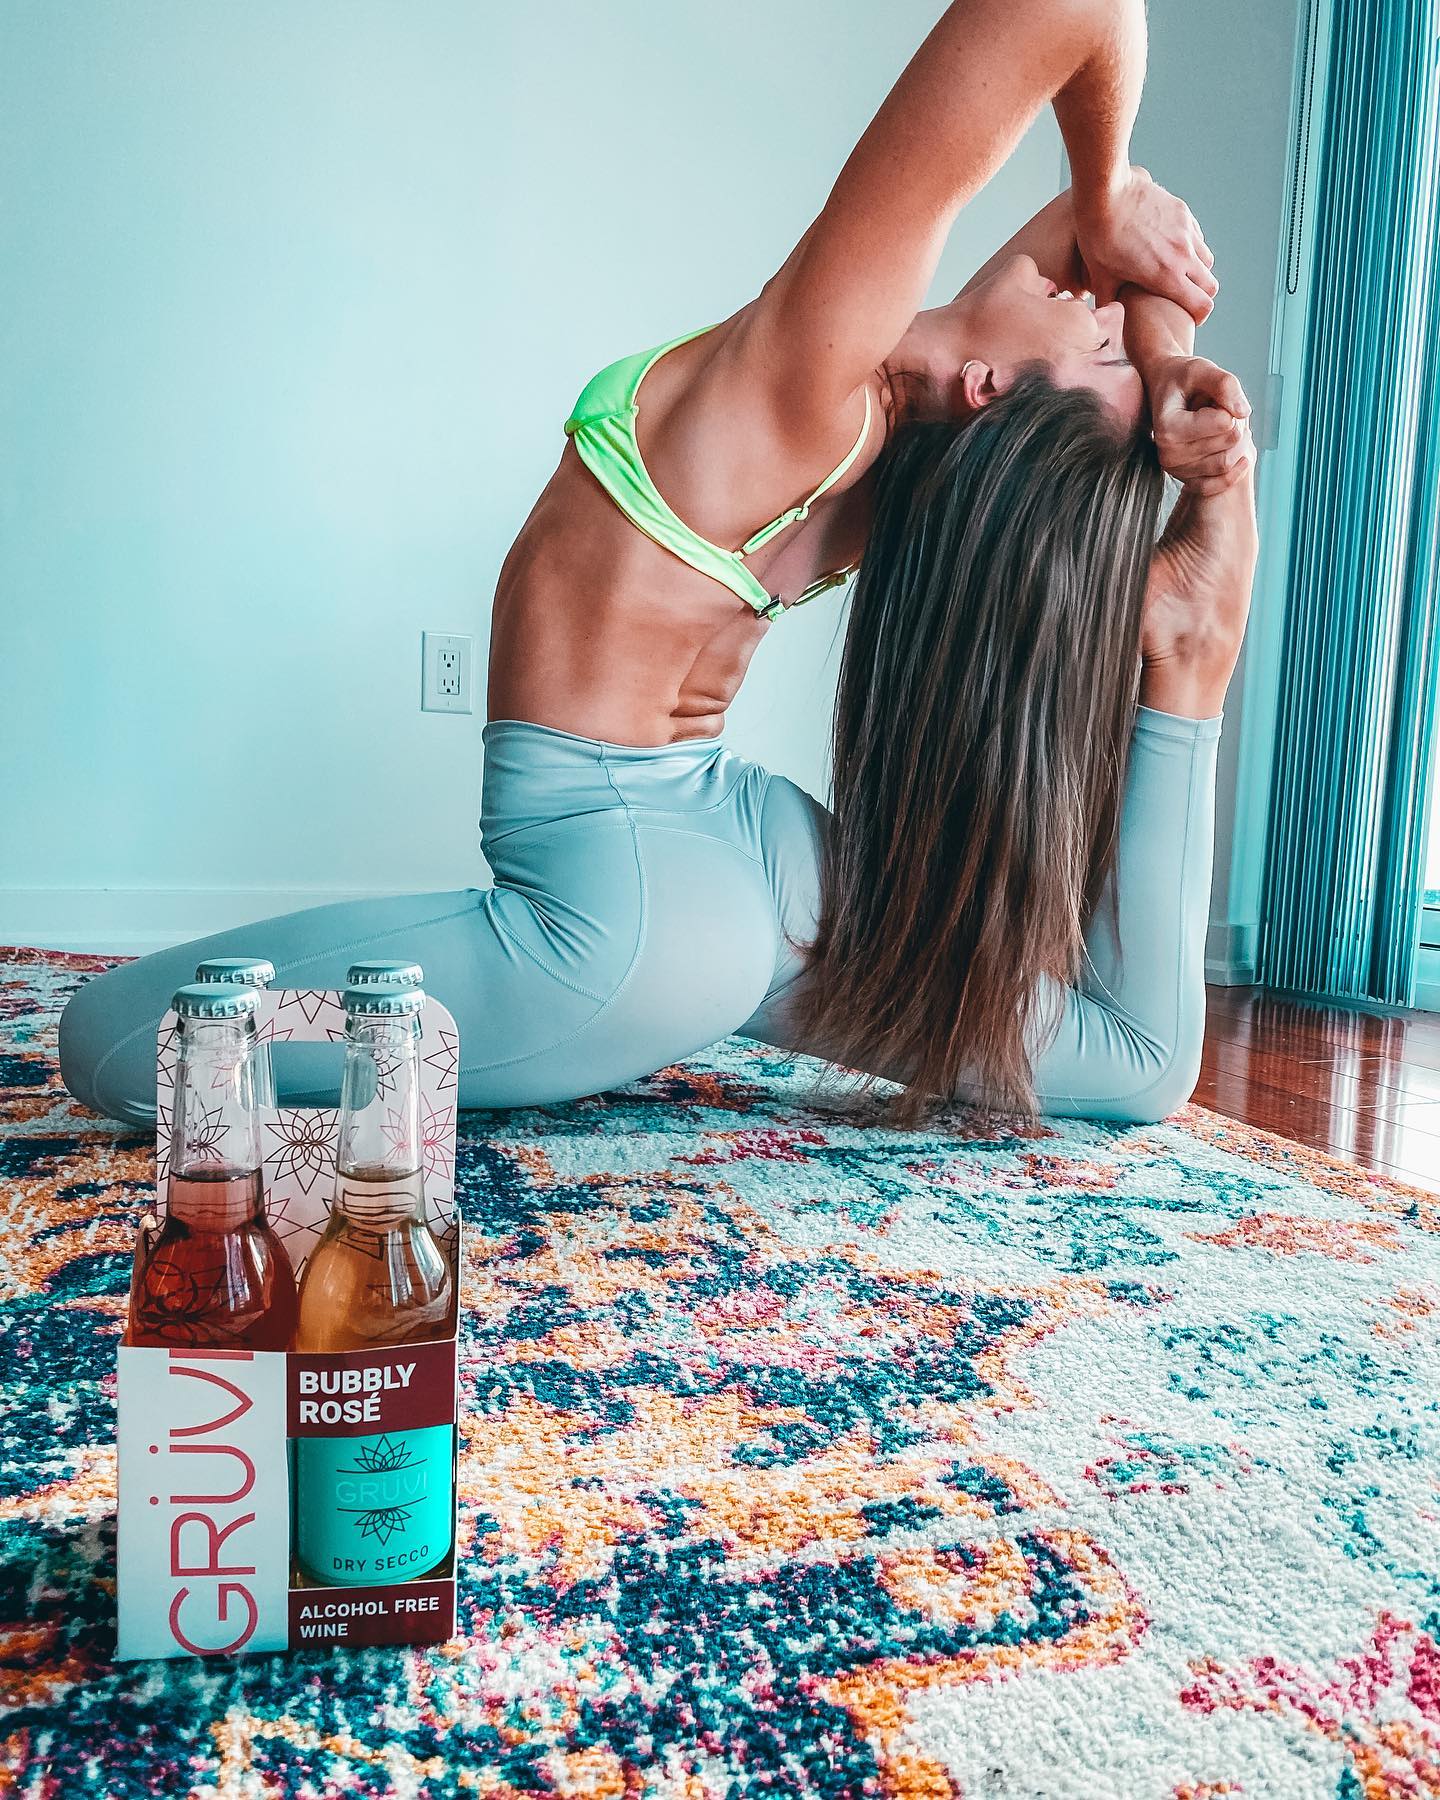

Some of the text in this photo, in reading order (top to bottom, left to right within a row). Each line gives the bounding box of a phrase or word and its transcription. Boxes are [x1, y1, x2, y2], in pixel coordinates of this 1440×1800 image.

[299, 1363, 417, 1394] BUBBLY
[299, 1392, 381, 1424] ROSÉ
[149, 1348, 257, 1656] GRÜVI
[333, 1545, 429, 1572] DRY SECCO
[300, 1597, 440, 1619] ALCOHOL FREE
[300, 1623, 348, 1638] WINE
